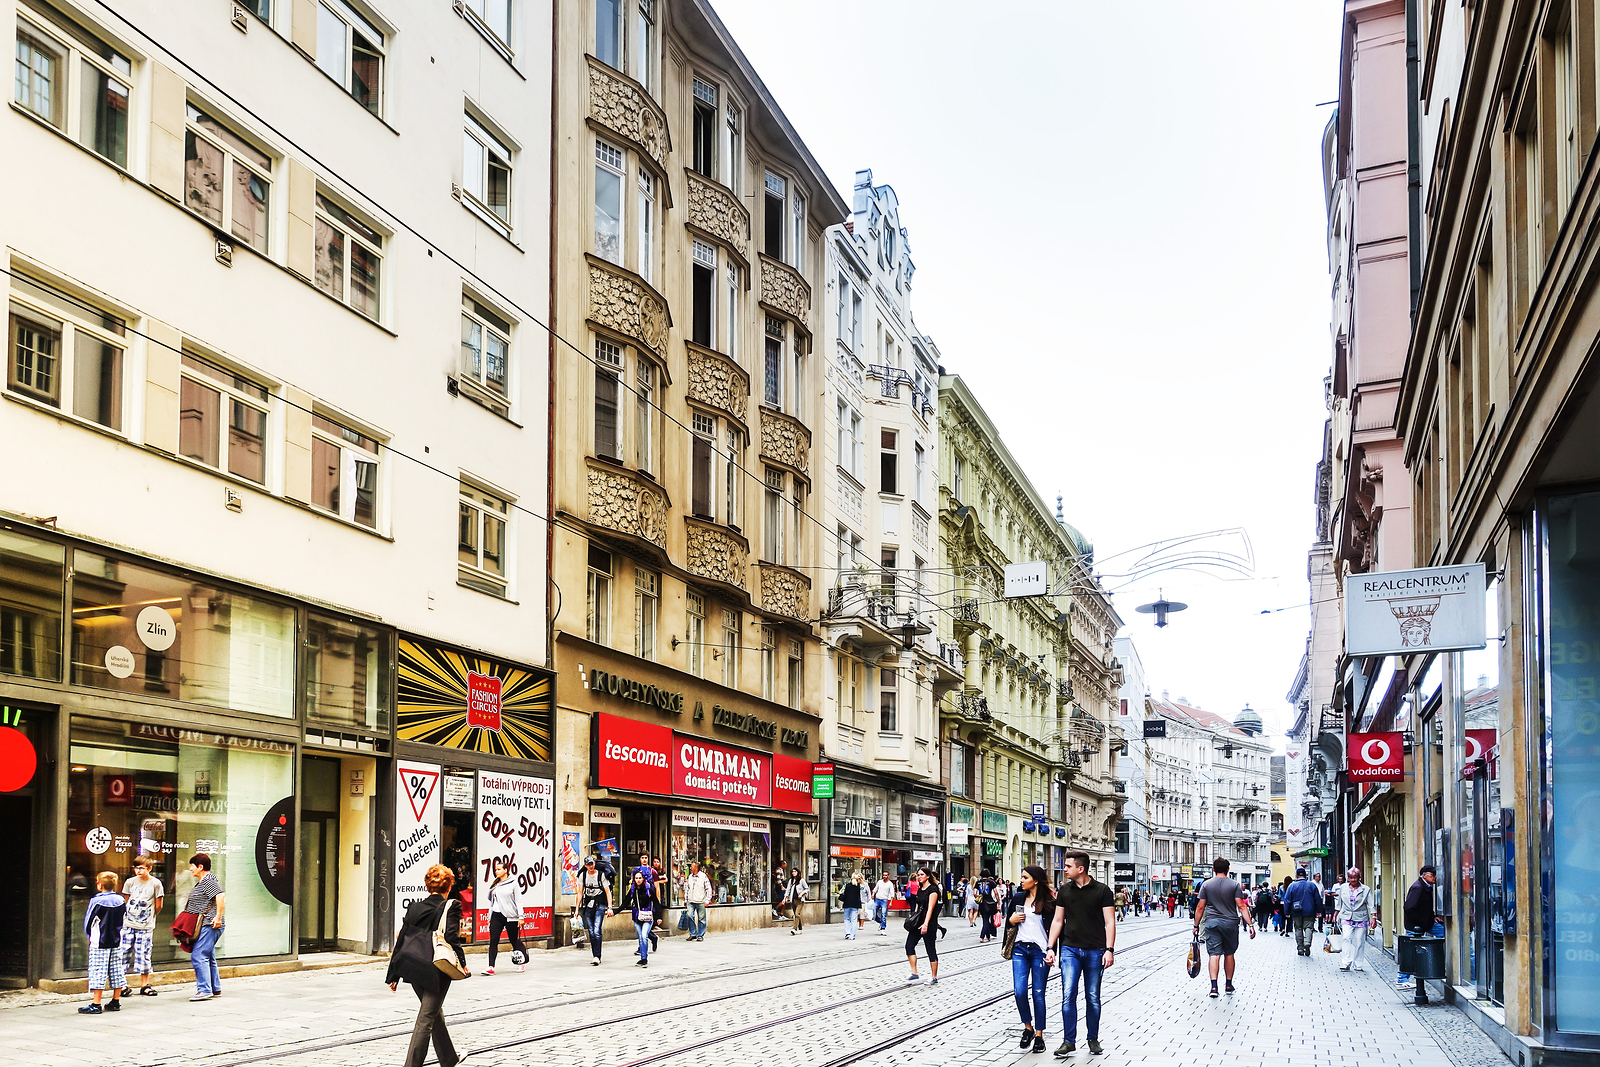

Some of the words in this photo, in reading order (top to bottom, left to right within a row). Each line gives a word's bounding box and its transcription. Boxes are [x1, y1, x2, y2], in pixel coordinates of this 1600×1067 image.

[1364, 574, 1466, 592] REALCENTRUM
[146, 622, 167, 636] Zlín
[471, 688, 498, 704] FASHION
[471, 700, 498, 714] CIRCUS
[693, 700, 705, 721] A
[605, 739, 669, 768] tescoma.
[680, 743, 762, 781] CIMRMAN
[1352, 767, 1401, 776] vodafone
[482, 776, 510, 790] Totální
[685, 772, 721, 791] domácí
[722, 780, 758, 800] potřeby
[775, 773, 811, 793] tescoma.
[481, 793, 522, 811] značkový
[524, 796, 551, 810] TEXTL
[398, 824, 431, 853] Outlet
[481, 810, 515, 849] 60%
[518, 815, 550, 850] 50%
[398, 834, 439, 874] oblečení
[481, 852, 518, 883] 70%
[517, 857, 550, 895] 90%
[397, 885, 416, 893] VERO
[539, 909, 550, 920] Šaty
